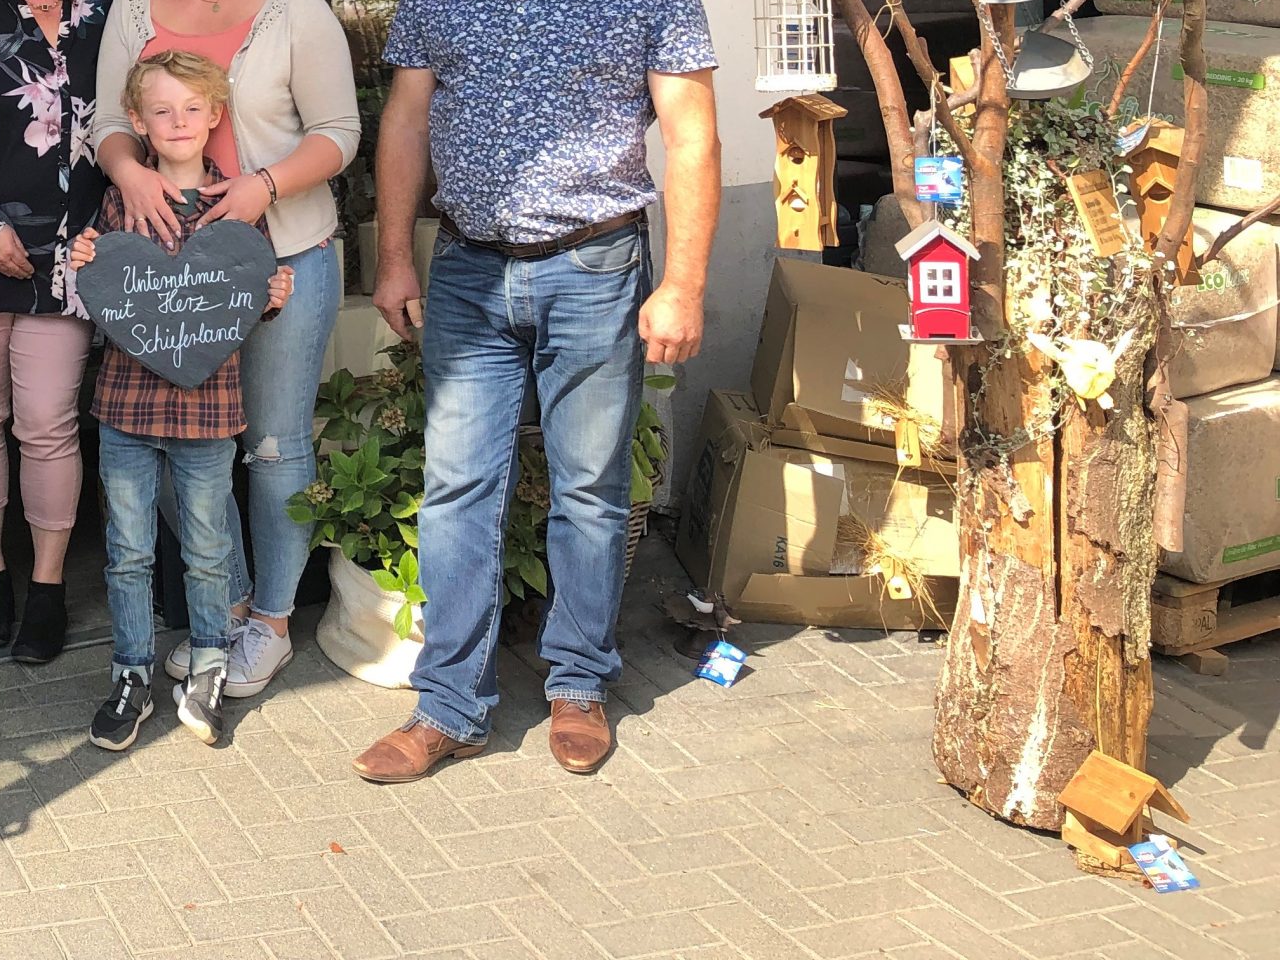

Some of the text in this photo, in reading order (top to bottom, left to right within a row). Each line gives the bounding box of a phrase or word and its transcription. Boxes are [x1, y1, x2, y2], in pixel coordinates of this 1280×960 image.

[123, 263, 231, 295] Unternehmen
[101, 286, 254, 323] mit Herz im
[127, 318, 244, 368] Schieferland
